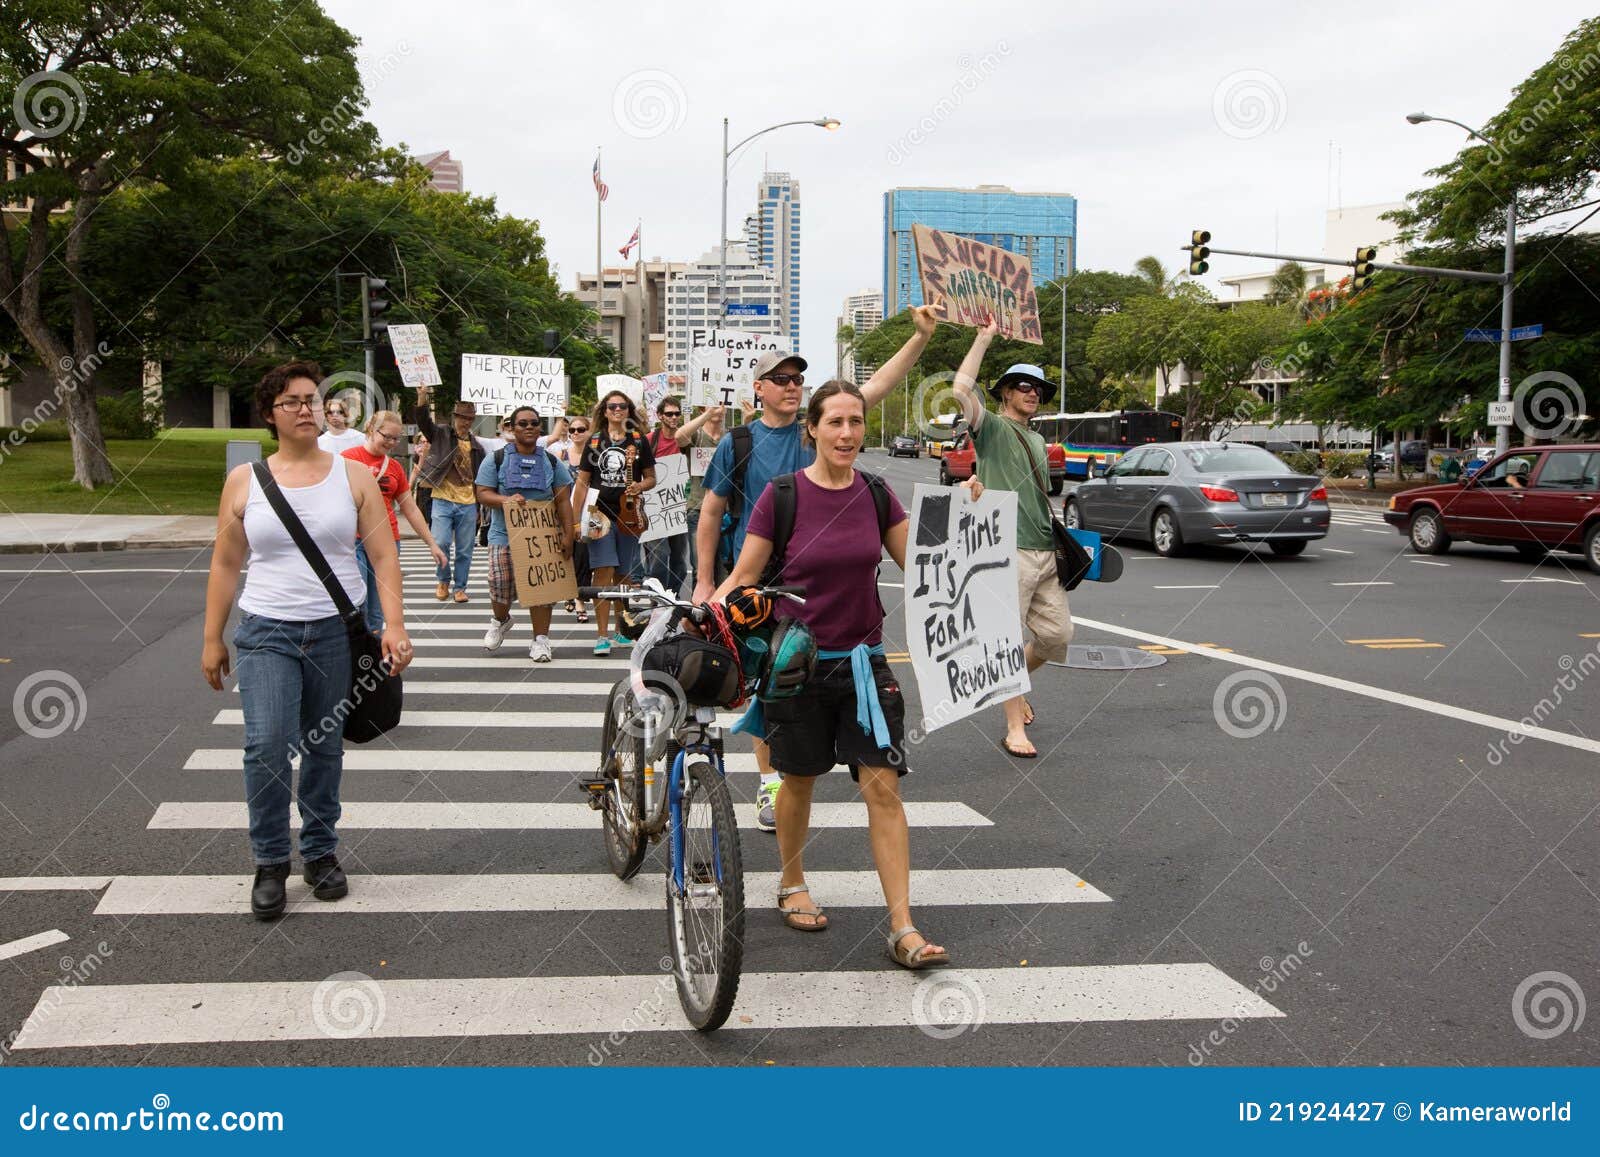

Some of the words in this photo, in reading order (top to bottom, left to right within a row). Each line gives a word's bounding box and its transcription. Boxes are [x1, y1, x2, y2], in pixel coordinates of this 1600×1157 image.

[693, 330, 777, 350] Education
[464, 356, 493, 371] THE
[500, 357, 564, 376] REVOLU-
[507, 376, 553, 390] TION
[469, 387, 505, 400] WILL
[514, 390, 547, 401] NOT
[547, 392, 565, 405] BE
[1494, 405, 1507, 413] NO
[510, 507, 561, 529] CAPITALIS
[525, 536, 542, 559] IS
[528, 560, 566, 587] CRISIS
[924, 613, 960, 657] FOR
[963, 592, 976, 632] A
[947, 637, 1025, 703] Revolution
